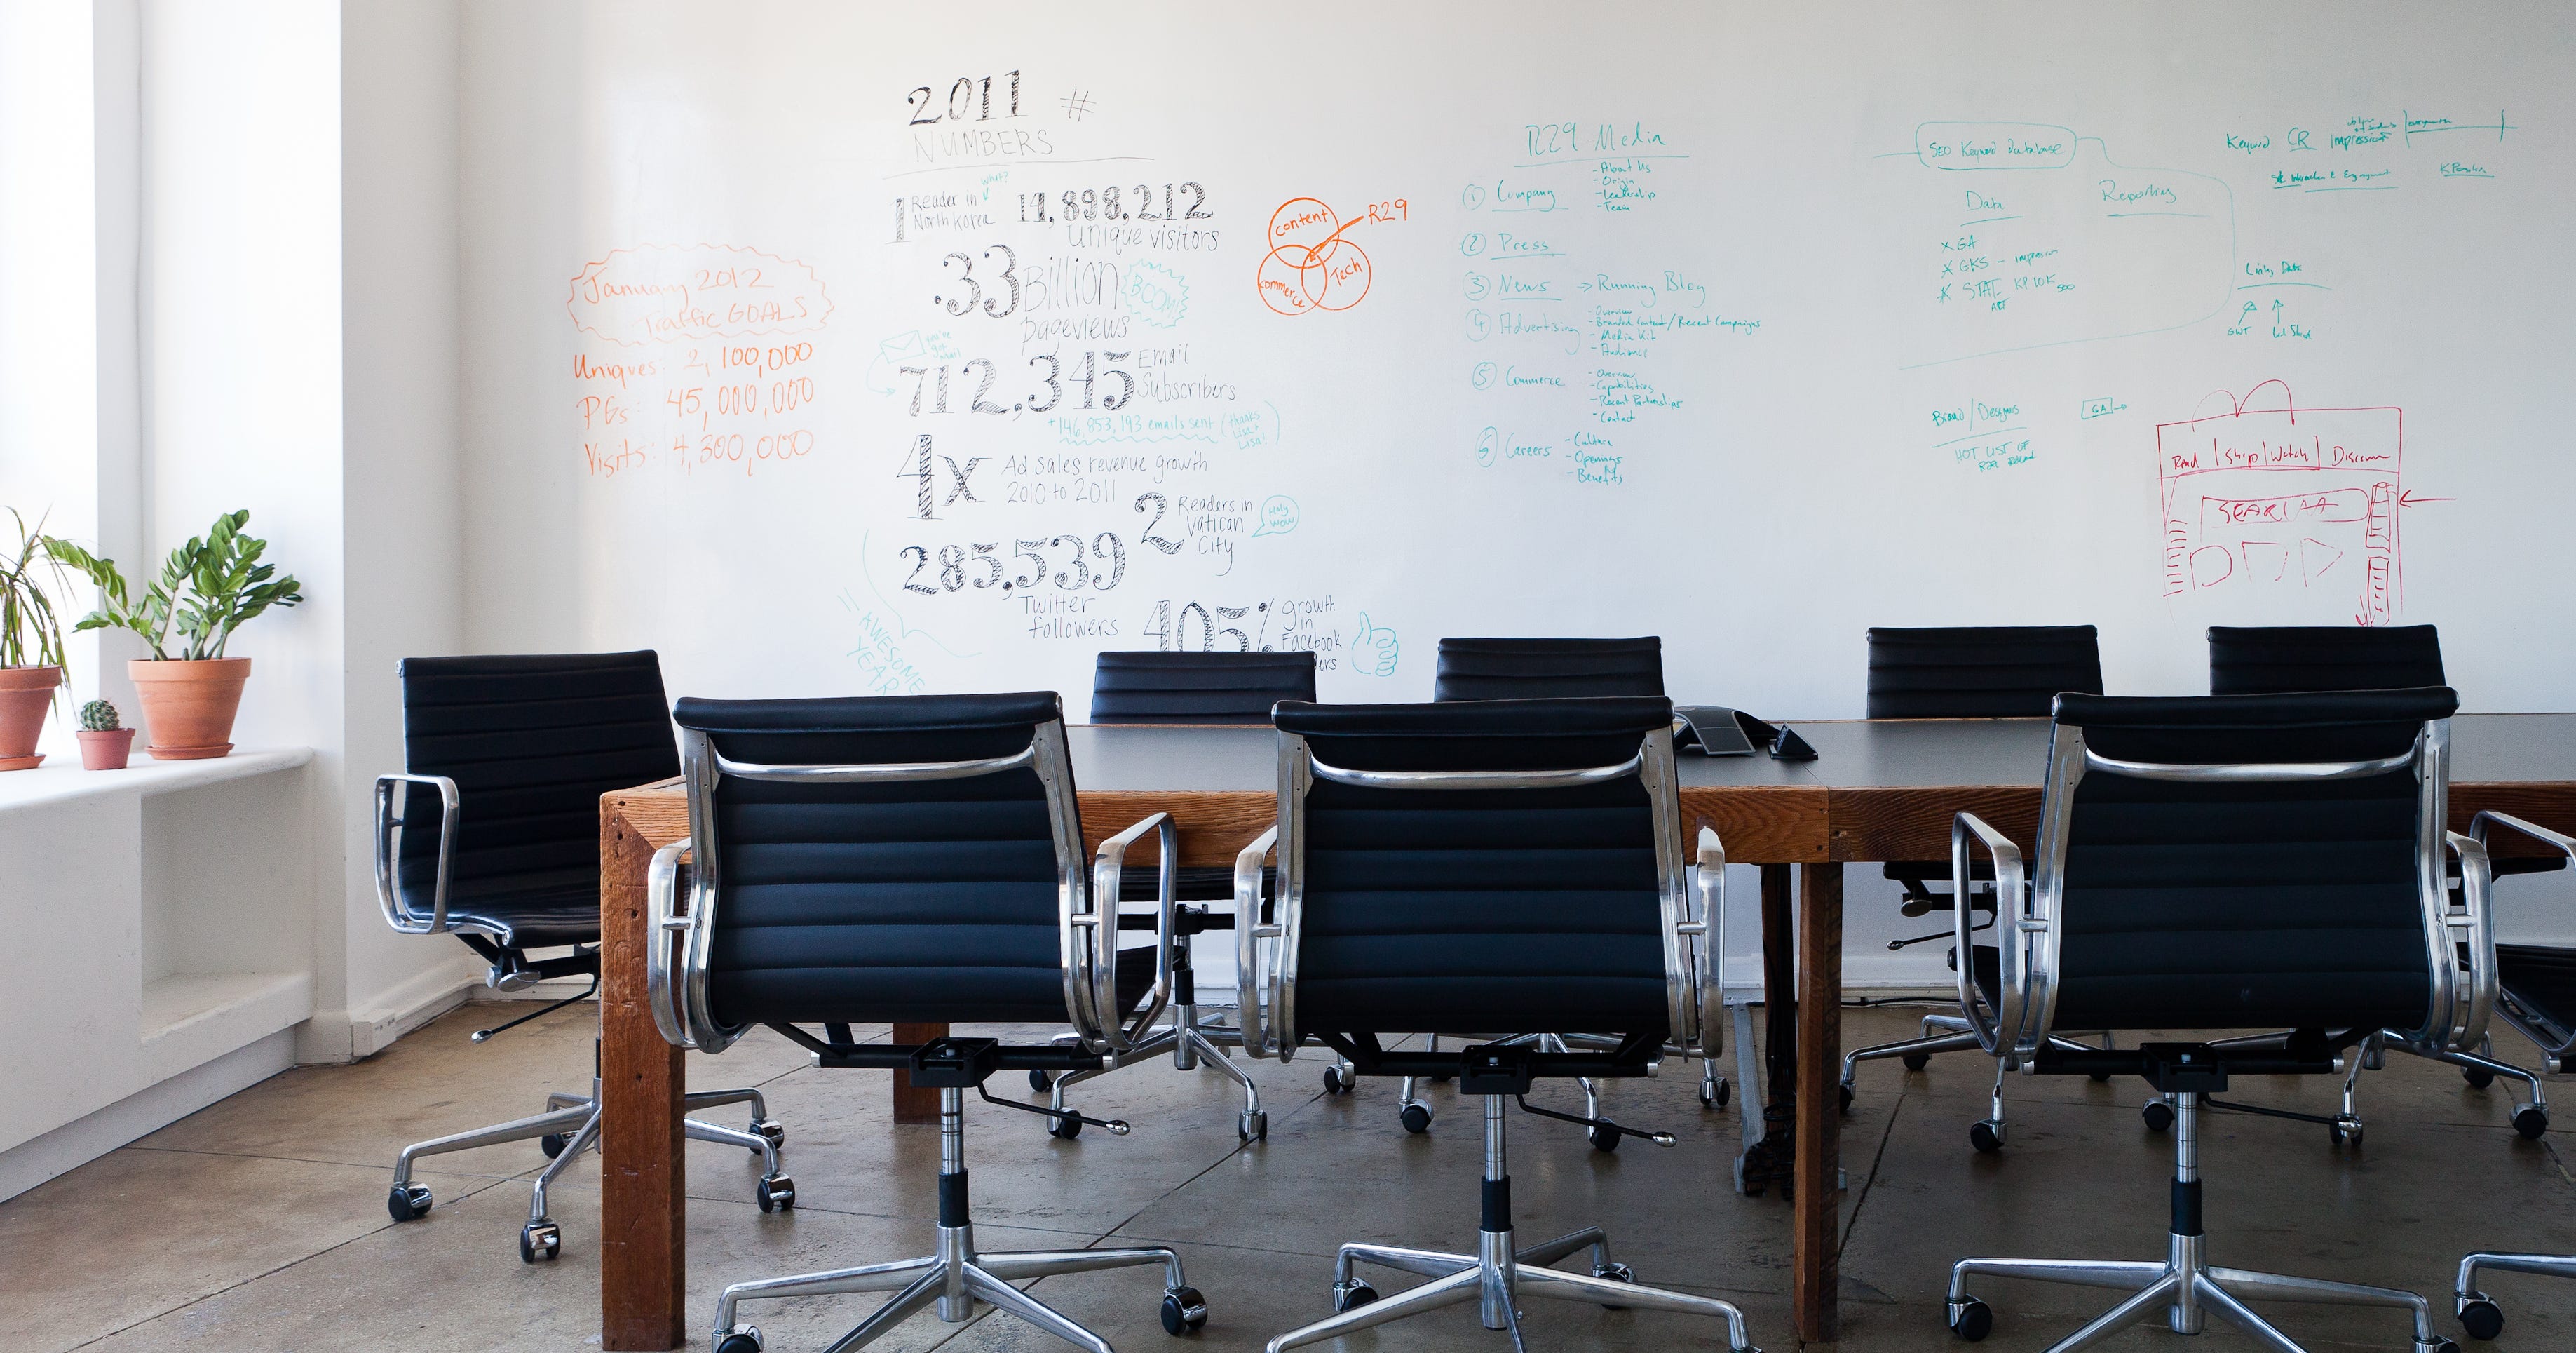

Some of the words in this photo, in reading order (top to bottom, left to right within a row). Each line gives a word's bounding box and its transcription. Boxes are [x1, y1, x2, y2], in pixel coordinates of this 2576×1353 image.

[907, 69, 1028, 126] 2011
[914, 128, 1053, 163] NUMBERS
[1525, 122, 1578, 156] R29
[1930, 142, 1951, 157] SEO
[912, 191, 956, 208] Reader
[965, 189, 977, 206] in
[1498, 179, 1555, 212] Company
[1967, 191, 2006, 211] Data
[2099, 180, 2176, 203] Reporting
[914, 213, 949, 230] North
[953, 210, 995, 231] Korea
[1369, 199, 1407, 224] R29
[1066, 224, 1142, 253] Unique
[1150, 220, 1219, 251] visitors
[1499, 234, 1549, 251] Press
[1957, 235, 1979, 250] GA
[1330, 257, 1362, 287] Tech
[1959, 256, 1989, 272] GKS
[582, 267, 688, 314] January
[696, 268, 774, 290] 2012
[1023, 257, 1119, 312] Billion
[1498, 274, 1550, 293] News
[1597, 274, 1656, 308] Running
[1664, 270, 1706, 308] Blog
[632, 308, 721, 337] Traffic
[728, 297, 808, 324] GOALS
[1022, 315, 1130, 356] pageviews
[1501, 313, 1580, 355] Advertising
[1139, 343, 1188, 368] Email
[900, 350, 1134, 421] 712,345
[1137, 372, 1235, 403] Subscribers
[1506, 365, 1565, 386] Commerce
[667, 377, 813, 431] 45,000,000
[1148, 415, 1184, 431] emails
[1190, 414, 1214, 430] sent
[1506, 432, 1552, 459] Careers
[2017, 440, 2030, 452] OF
[1001, 455, 1027, 477] Ad
[1037, 456, 1080, 476] sales
[1089, 456, 1147, 475] revenue
[1154, 455, 1208, 484] growth
[1006, 481, 1046, 506] 2010
[1053, 483, 1066, 499] to
[1074, 478, 1116, 504] 2011
[1179, 494, 1234, 515] Readers
[1241, 499, 1254, 512] in
[1134, 492, 1184, 555] 2
[1186, 514, 1245, 534] Vatican
[900, 532, 1126, 600] 285,539
[1198, 535, 1233, 577] City
[1017, 593, 1096, 615] Twitter
[1282, 595, 1335, 631] growth
[1029, 617, 1118, 638] followers
[1143, 598, 1275, 652] 405%
[1301, 617, 1313, 629] in
[859, 611, 926, 694] AWESOME
[1282, 629, 1342, 652] Facebook
[846, 635, 900, 694] YEAR
